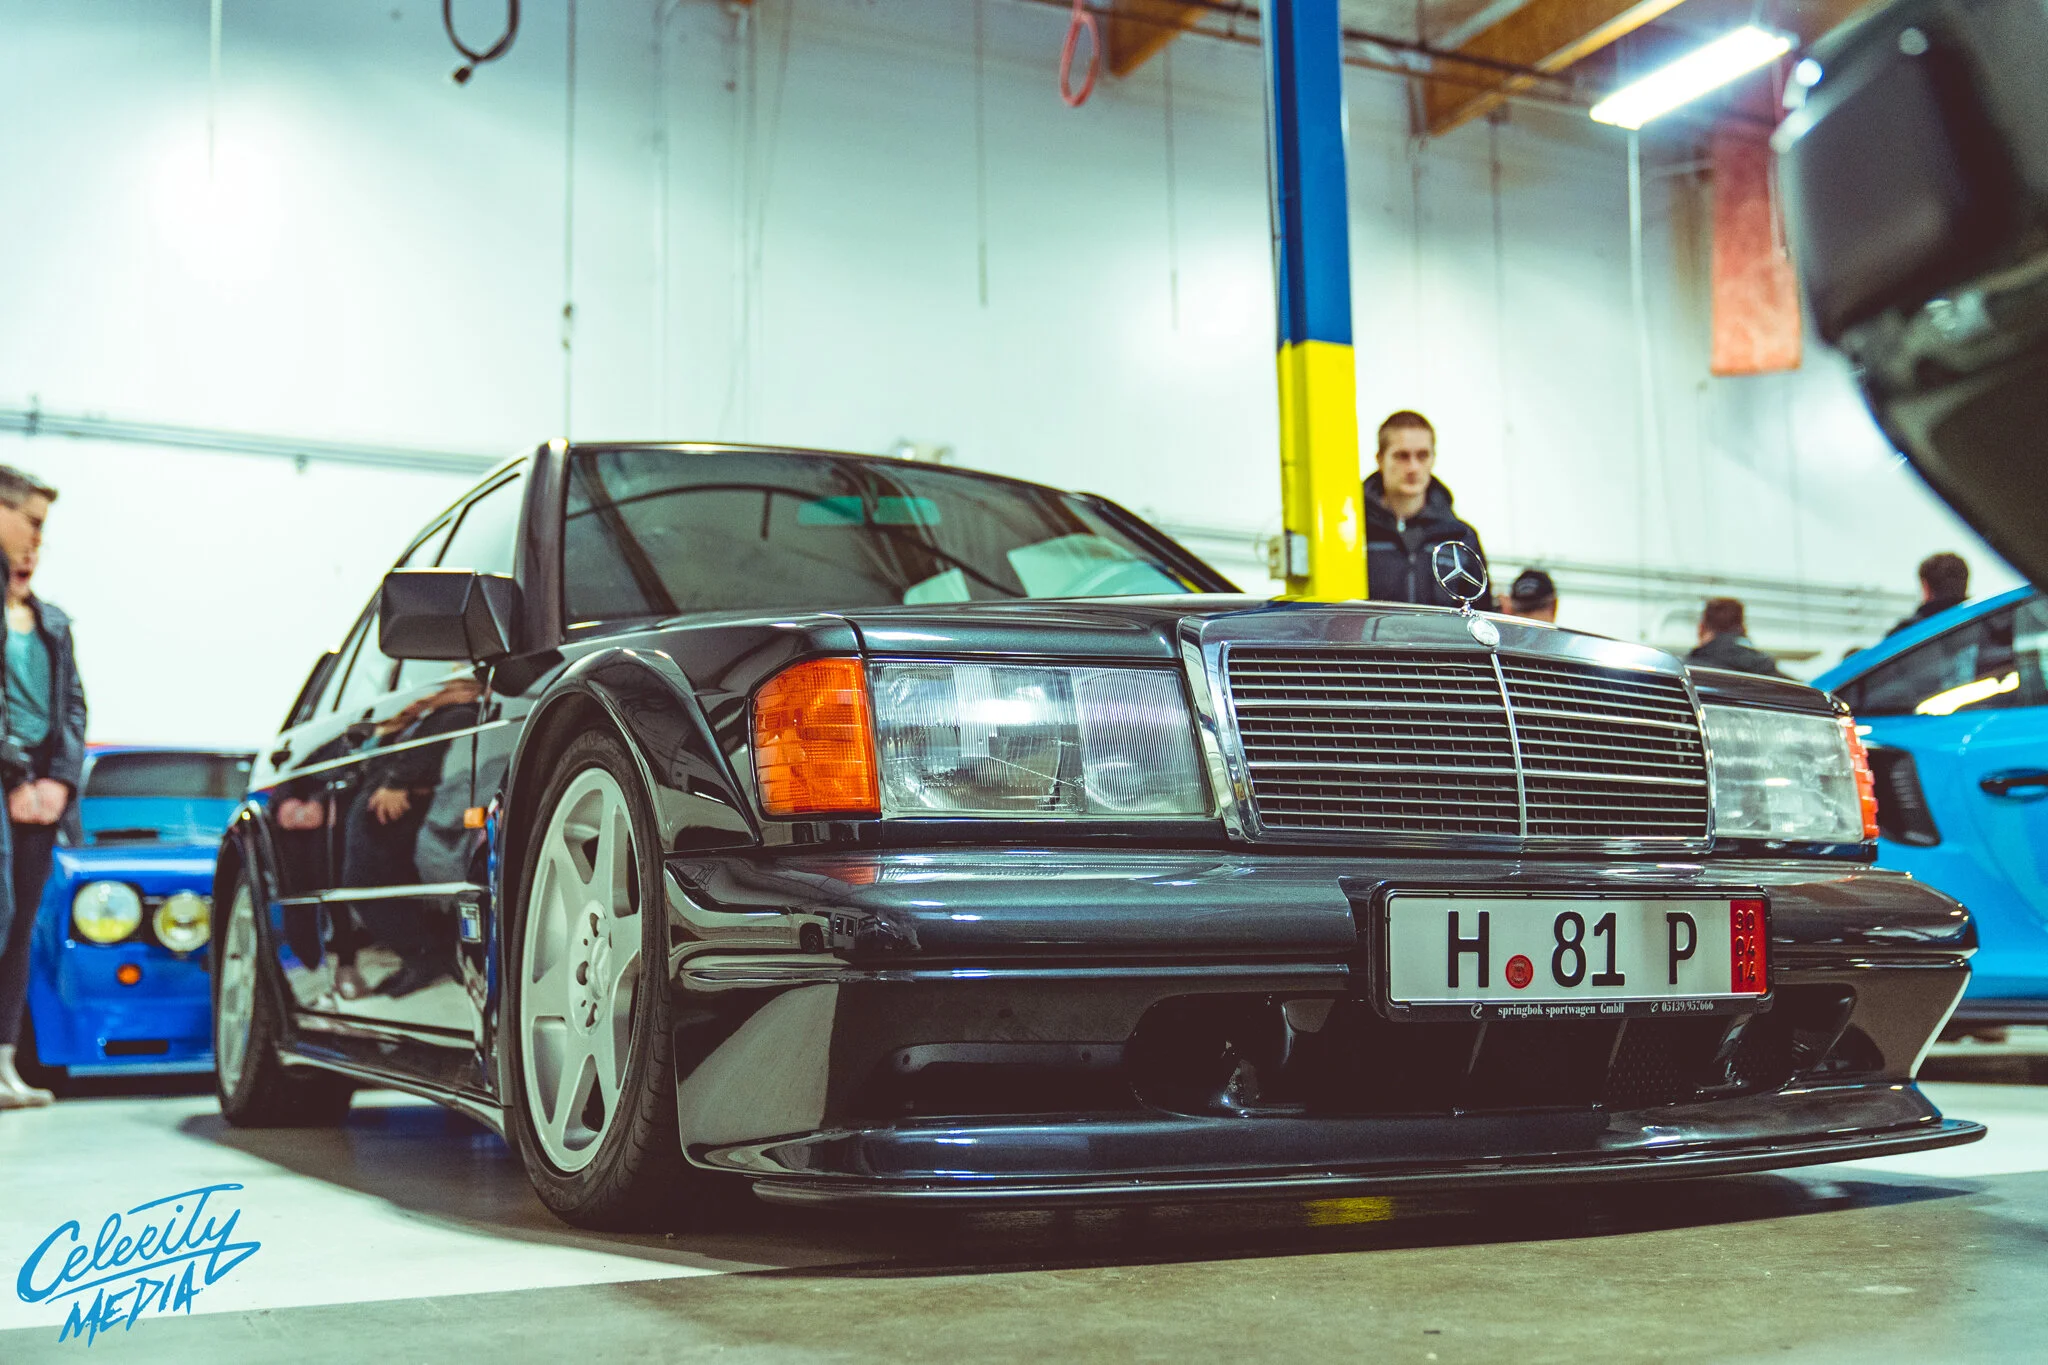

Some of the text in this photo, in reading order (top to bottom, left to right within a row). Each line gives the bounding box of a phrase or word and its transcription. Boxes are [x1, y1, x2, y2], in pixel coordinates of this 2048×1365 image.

[1736, 909, 1755, 931] 30
[1447, 910, 1697, 989] H 81 P
[1735, 935, 1756, 957] 04
[1737, 960, 1756, 983] 14
[1498, 1003, 1543, 1018] springbok
[1545, 1003, 1596, 1017] sportwagen
[1600, 1002, 1625, 1014] GmbH
